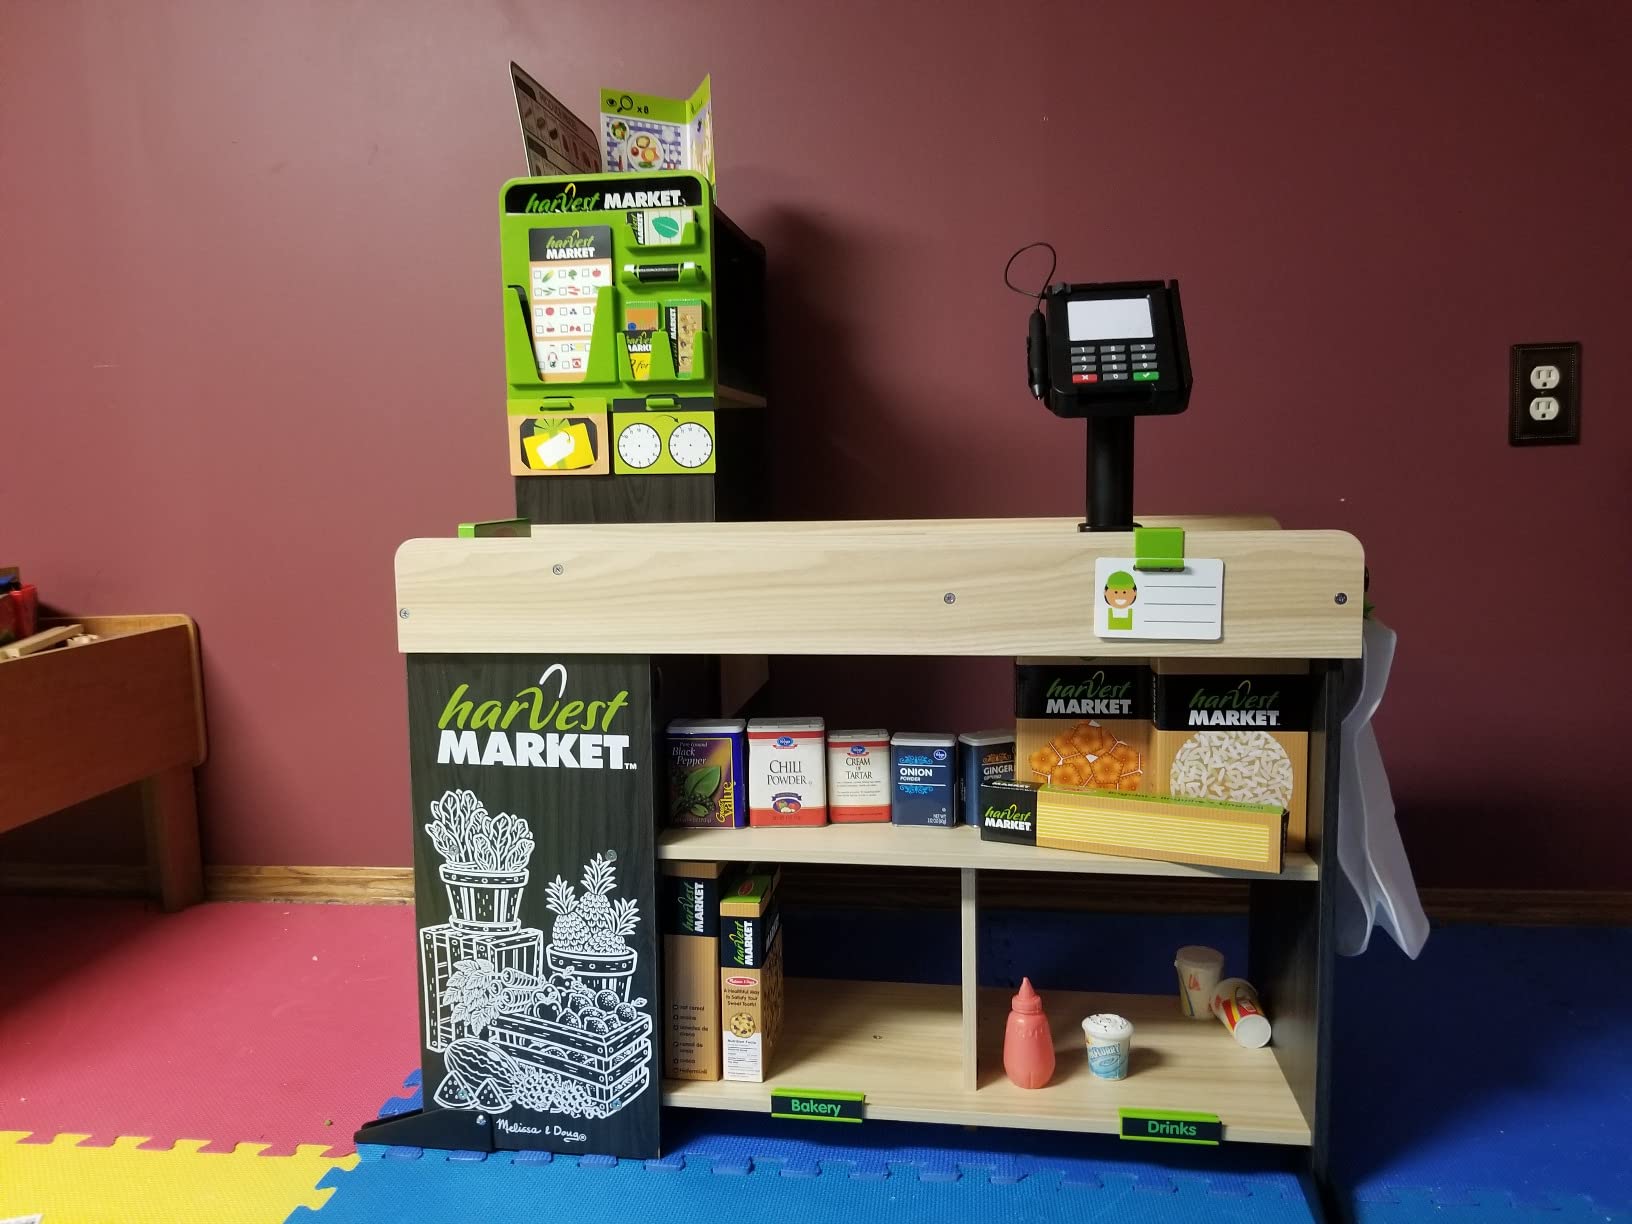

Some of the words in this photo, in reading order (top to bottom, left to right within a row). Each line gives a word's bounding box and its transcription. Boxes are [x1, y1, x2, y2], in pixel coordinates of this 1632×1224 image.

[525, 183, 600, 213] harvest
[604, 190, 681, 209] MARKET
[546, 229, 594, 249] harvest
[546, 247, 595, 260] MARKET
[628, 343, 652, 352] MARK
[1046, 671, 1131, 698] harvest
[437, 664, 629, 732] harvest
[1189, 680, 1280, 708] harvest
[1046, 699, 1131, 714] MARKET
[1189, 710, 1280, 726] MARKET
[437, 730, 630, 770] MARKET
[672, 746, 696, 757] Black
[676, 755, 706, 767] Pepper
[846, 758, 870, 766] CREAM
[846, 771, 872, 779] TARTAR
[900, 768, 933, 777] ONION
[984, 765, 1013, 775] GINGER
[768, 775, 807, 785] POWDER
[985, 804, 1031, 821] harvest
[985, 818, 1032, 831] MARKET
[678, 881, 694, 931] harvest
[694, 882, 704, 932] MARKET
[730, 921, 744, 965] harvest
[744, 921, 753, 965] MARKET
[792, 1099, 841, 1116] Bakery
[496, 1118, 542, 1134] Melissa
[1148, 1121, 1197, 1136] Drinks
